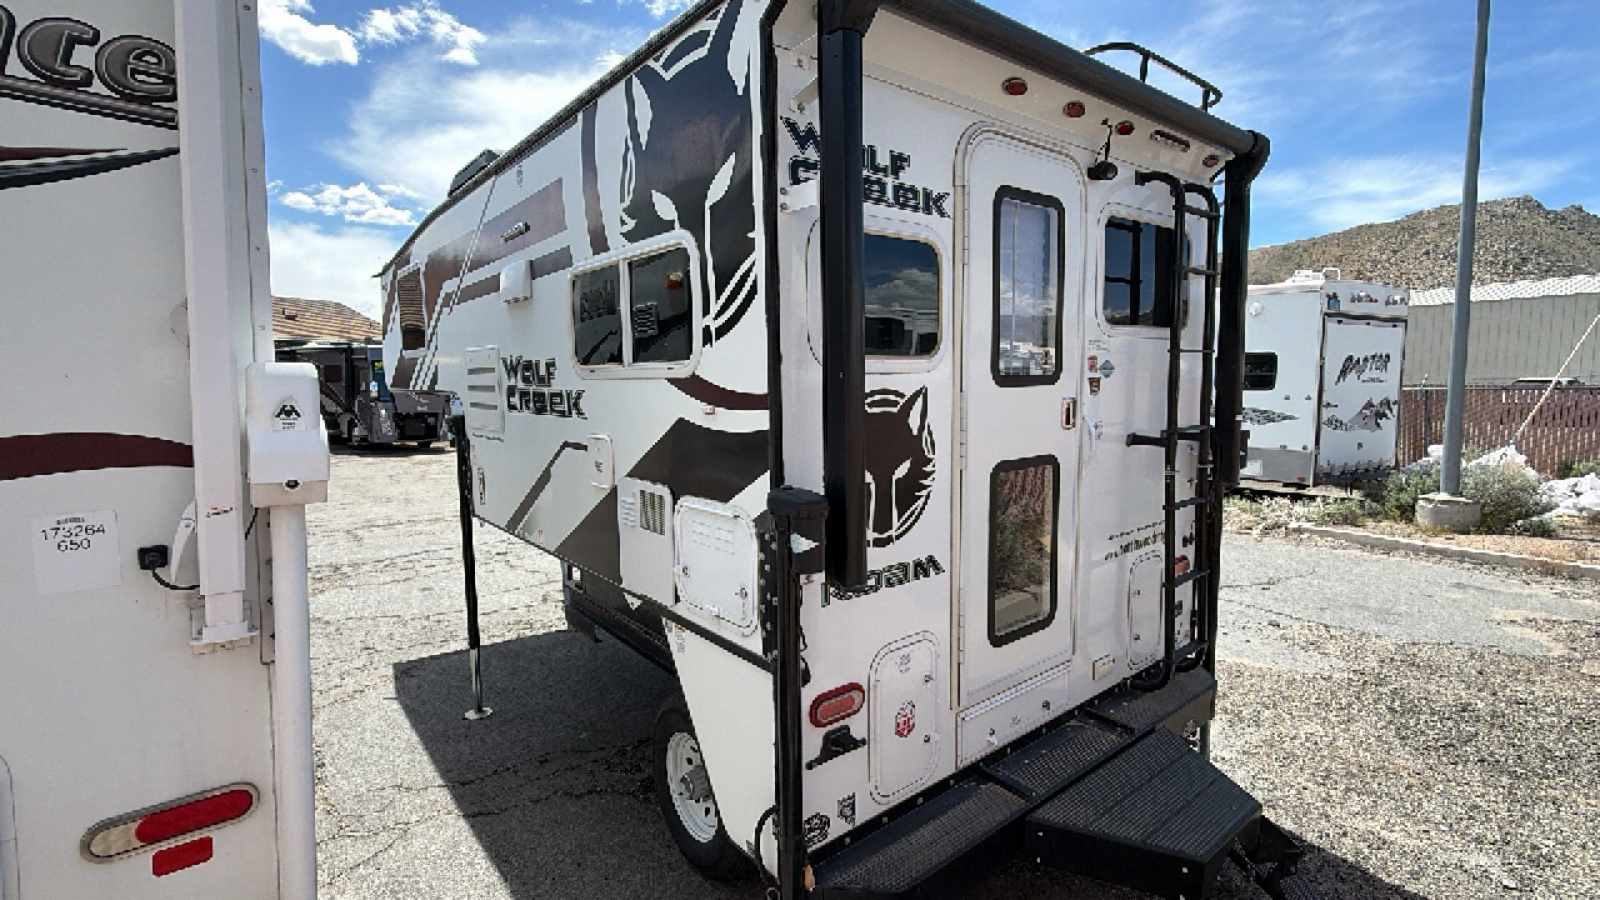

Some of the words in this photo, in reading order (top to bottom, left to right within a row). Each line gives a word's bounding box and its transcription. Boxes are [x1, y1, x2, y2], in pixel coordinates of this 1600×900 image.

[0, 4, 178, 103] ce
[779, 115, 911, 181] WLF
[500, 355, 556, 387] WOLF
[1334, 352, 1391, 386] RAPTOR
[41, 524, 105, 541] 173264
[57, 538, 91, 552] 650
